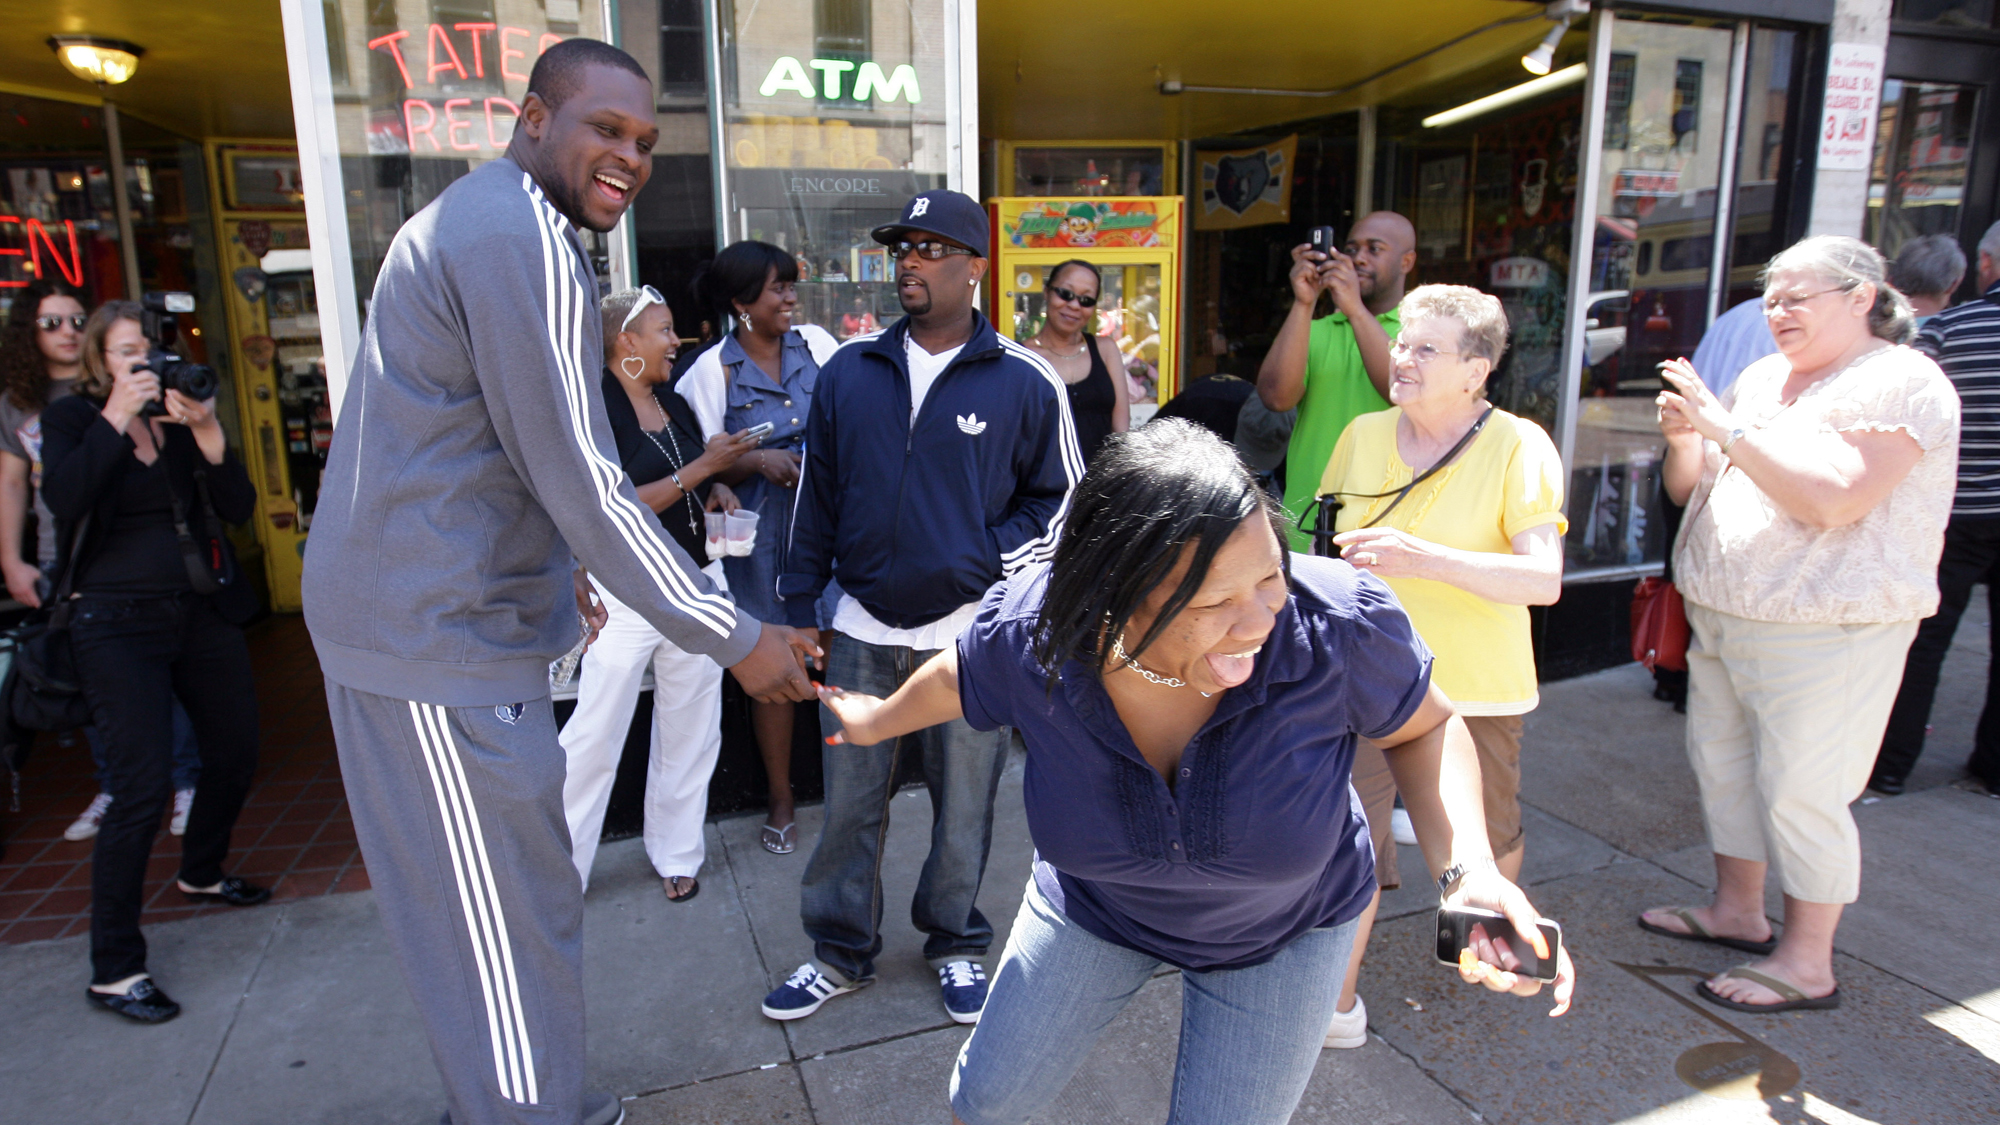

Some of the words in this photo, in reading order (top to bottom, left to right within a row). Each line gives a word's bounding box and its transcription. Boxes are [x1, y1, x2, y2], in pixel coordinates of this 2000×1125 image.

[759, 56, 922, 104] ATM
[1827, 75, 1859, 90] BEALE
[1825, 95, 1860, 110] CLEARED
[1863, 96, 1874, 110] AT
[1824, 115, 1836, 140] 3
[790, 177, 881, 193] ENCORE
[909, 197, 930, 219] D
[1015, 211, 1065, 238] Toy
[1497, 264, 1541, 280] MTA
